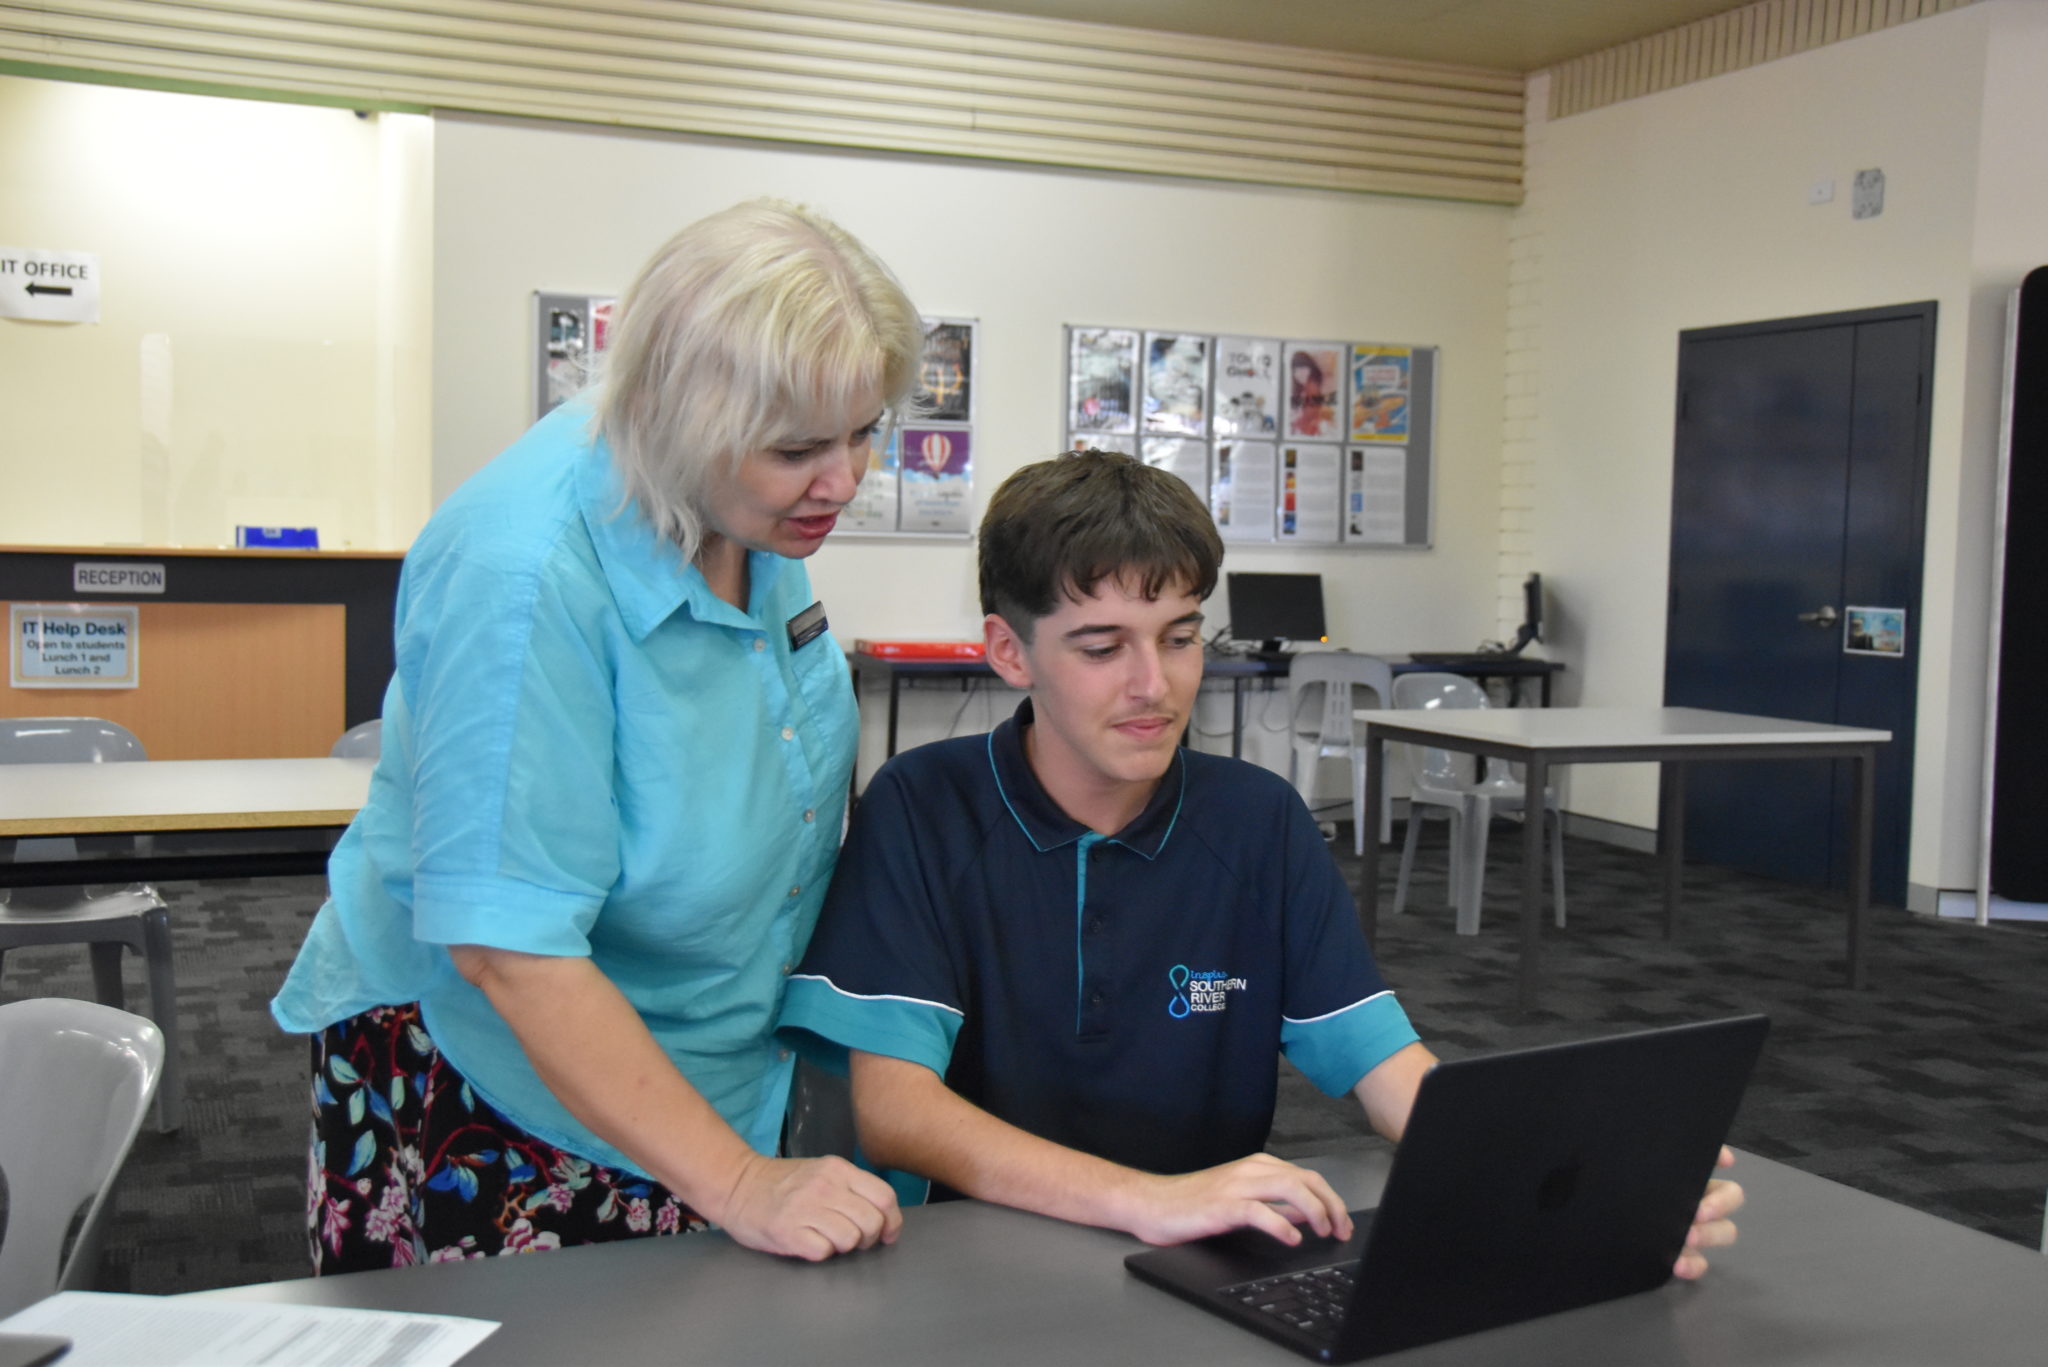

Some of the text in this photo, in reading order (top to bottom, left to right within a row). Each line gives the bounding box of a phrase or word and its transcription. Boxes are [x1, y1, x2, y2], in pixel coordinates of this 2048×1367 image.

[2, 259, 88, 279] IT OFFICE
[79, 569, 162, 586] RECEPTION
[23, 621, 126, 638] IT Help Desk
[27, 639, 126, 651] Open to students
[42, 653, 78, 663] Lunch
[89, 653, 111, 663] and
[55, 665, 101, 675] Lunch 2
[1190, 978, 1247, 992] SOUTHERN
[1191, 991, 1226, 1004] RIVER
[1191, 1003, 1226, 1012] COLLEGE
